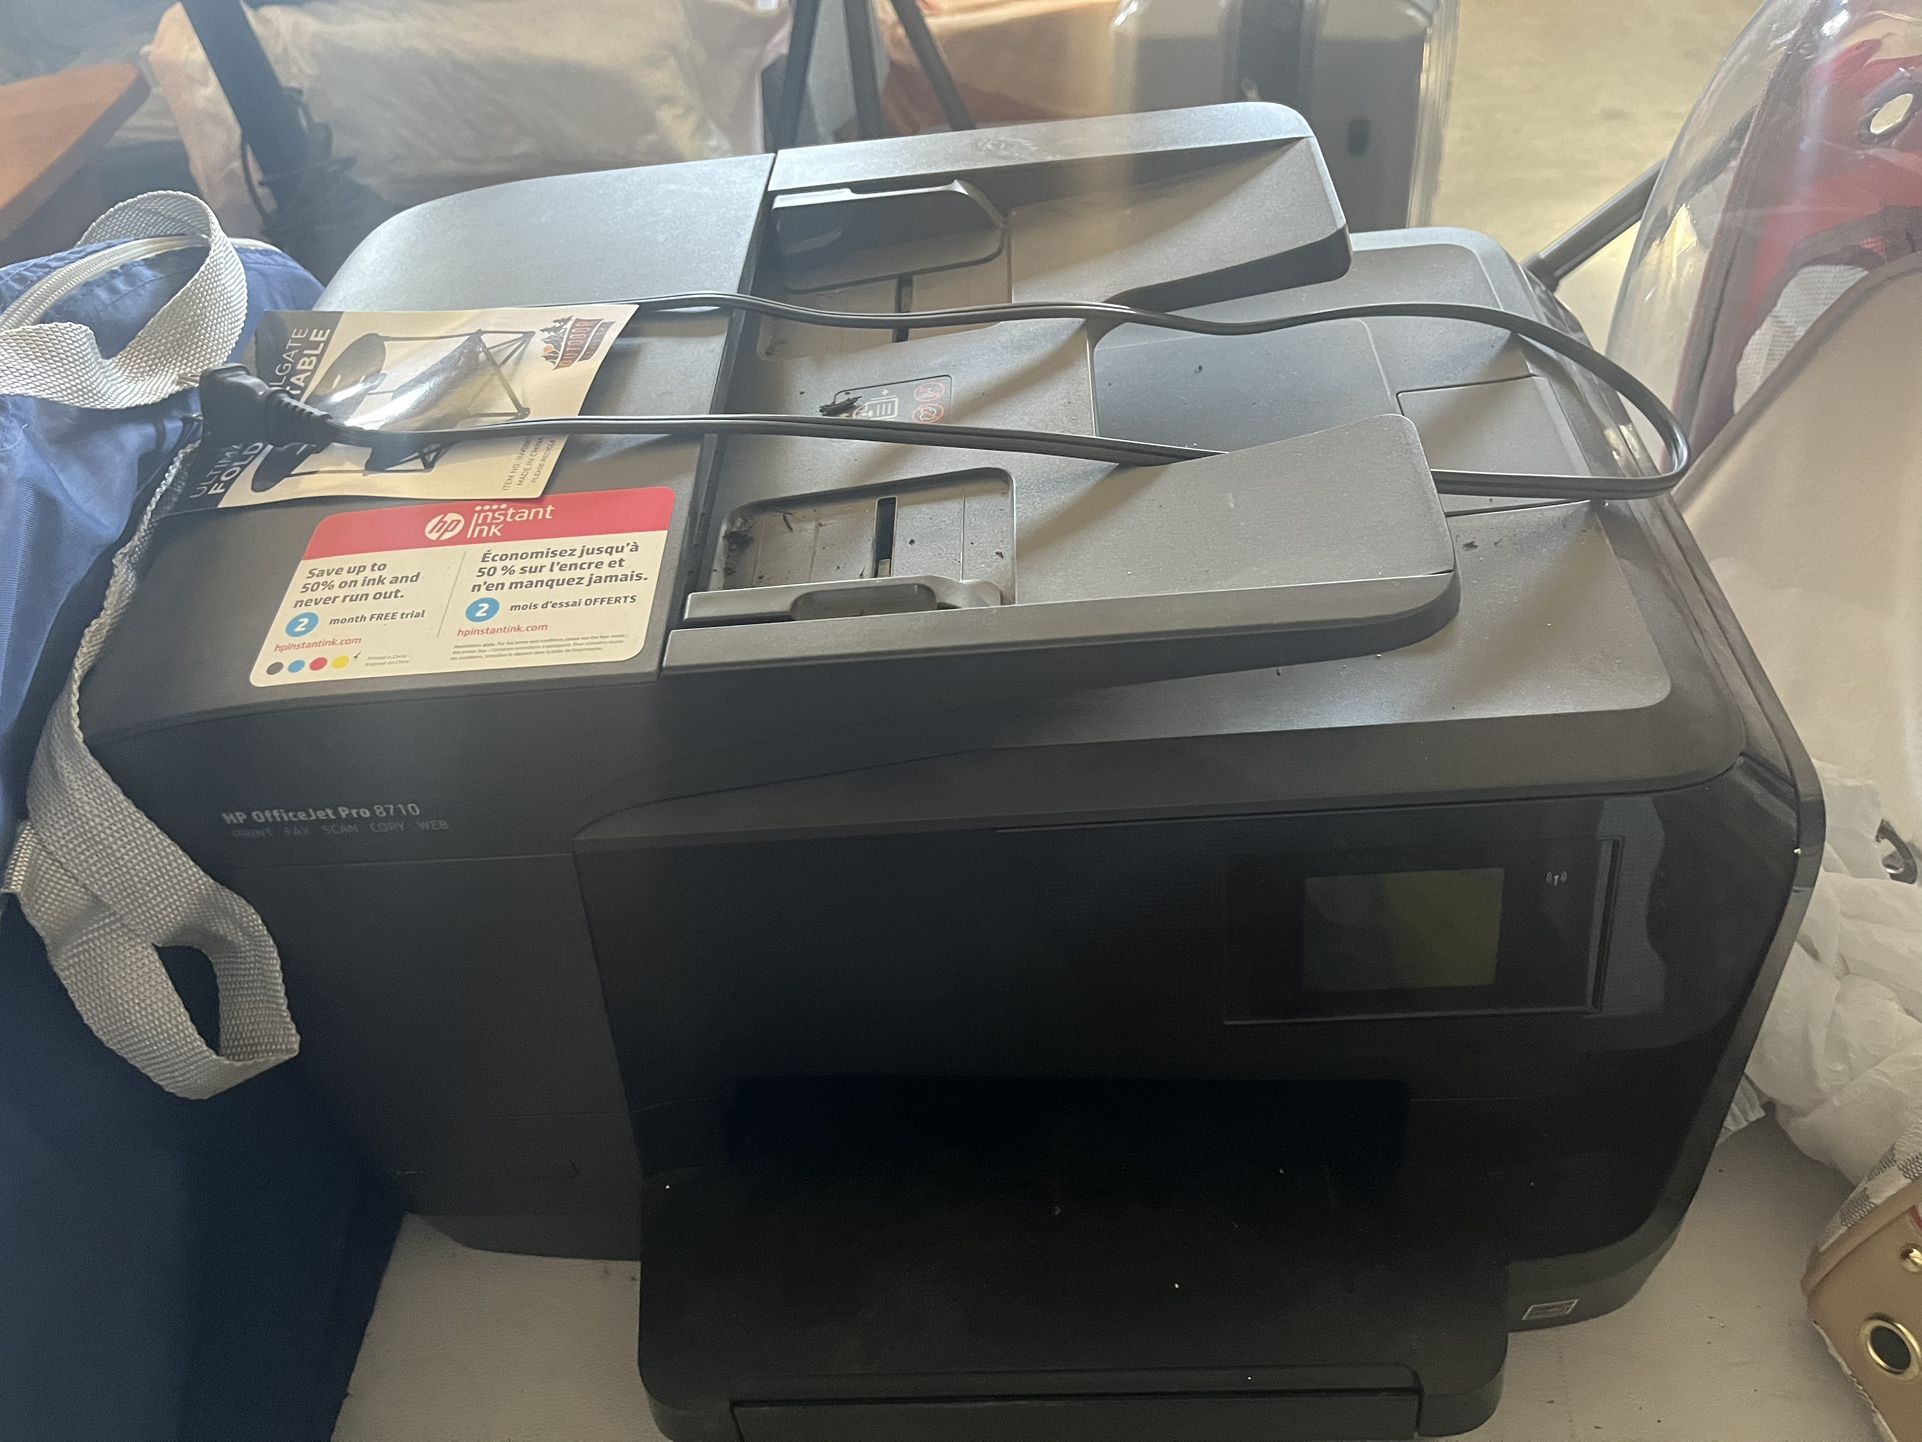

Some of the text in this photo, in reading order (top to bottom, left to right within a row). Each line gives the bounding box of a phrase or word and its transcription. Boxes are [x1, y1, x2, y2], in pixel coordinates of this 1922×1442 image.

[424, 512, 465, 541] hp
[480, 547, 579, 563] Économisez
[306, 561, 388, 579] Save up to
[476, 557, 626, 578] 50 % sur l'encre et
[300, 571, 422, 594] 50% on ink and
[470, 570, 649, 593] n'en manquez jamais.
[293, 588, 405, 609] never run out.
[475, 595, 638, 618] 2 mois d'essai OFFERTS
[294, 609, 426, 633] 2 month FREE trial
[457, 622, 549, 638] hpinstantink.com
[274, 637, 362, 653] hpinstantink.com
[221, 803, 421, 825] HP OfficeJet Pro 8710
[283, 826, 310, 836] FAX
[320, 824, 360, 836] SCAN
[369, 821, 406, 833] COPY
[415, 820, 451, 831] WEB
